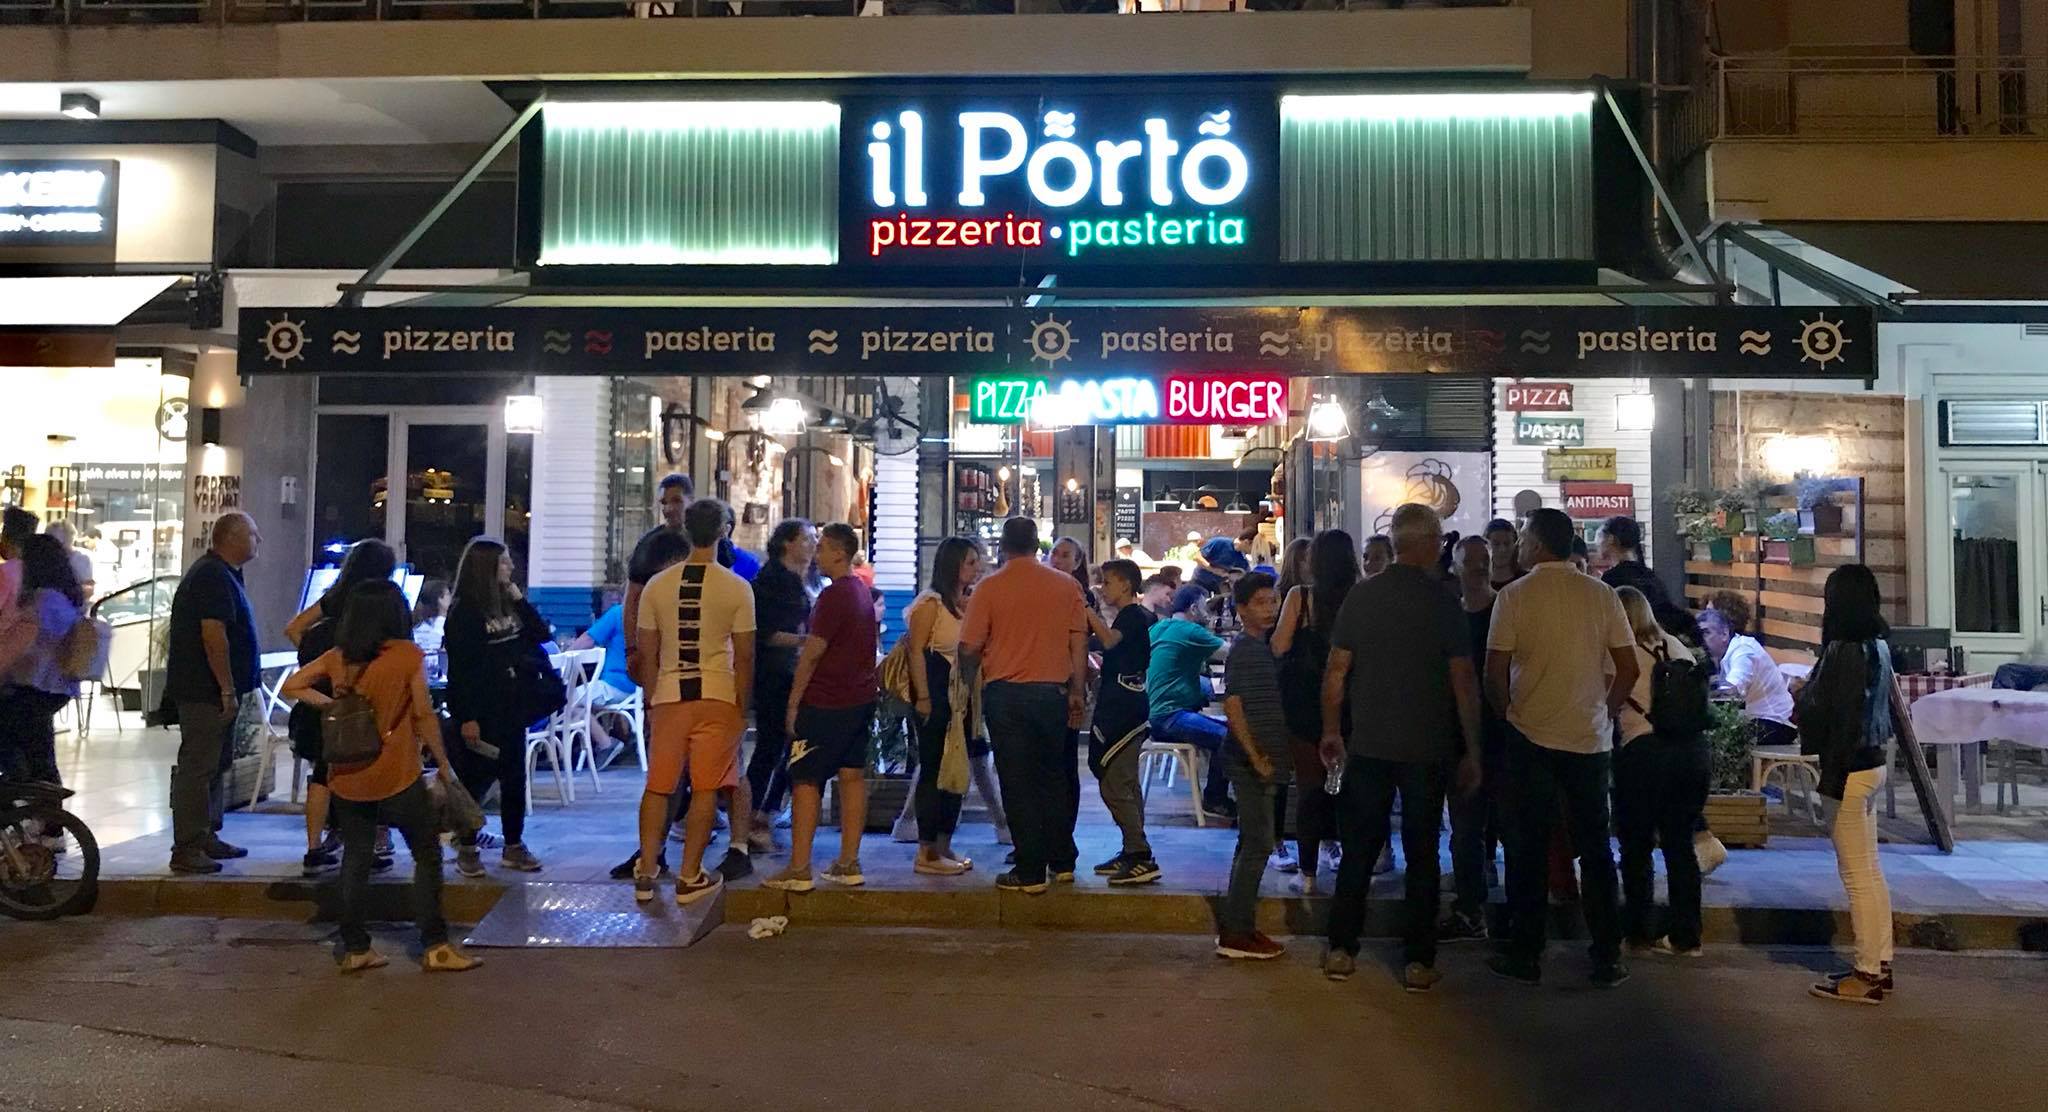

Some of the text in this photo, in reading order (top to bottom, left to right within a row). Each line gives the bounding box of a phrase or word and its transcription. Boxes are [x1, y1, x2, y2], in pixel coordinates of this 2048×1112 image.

[868, 110, 927, 207] il
[872, 212, 1244, 256] pizzeria pasteria
[383, 325, 1717, 361] pizzeria pasteria pizzeria pasteria pzeria pasteria
[1169, 380, 1284, 418] BURGER
[1508, 389, 1571, 405] PIZZA
[195, 475, 240, 490] FROZEN
[194, 493, 238, 510] YOGURT
[1567, 496, 1629, 509] ANTIPASTI
